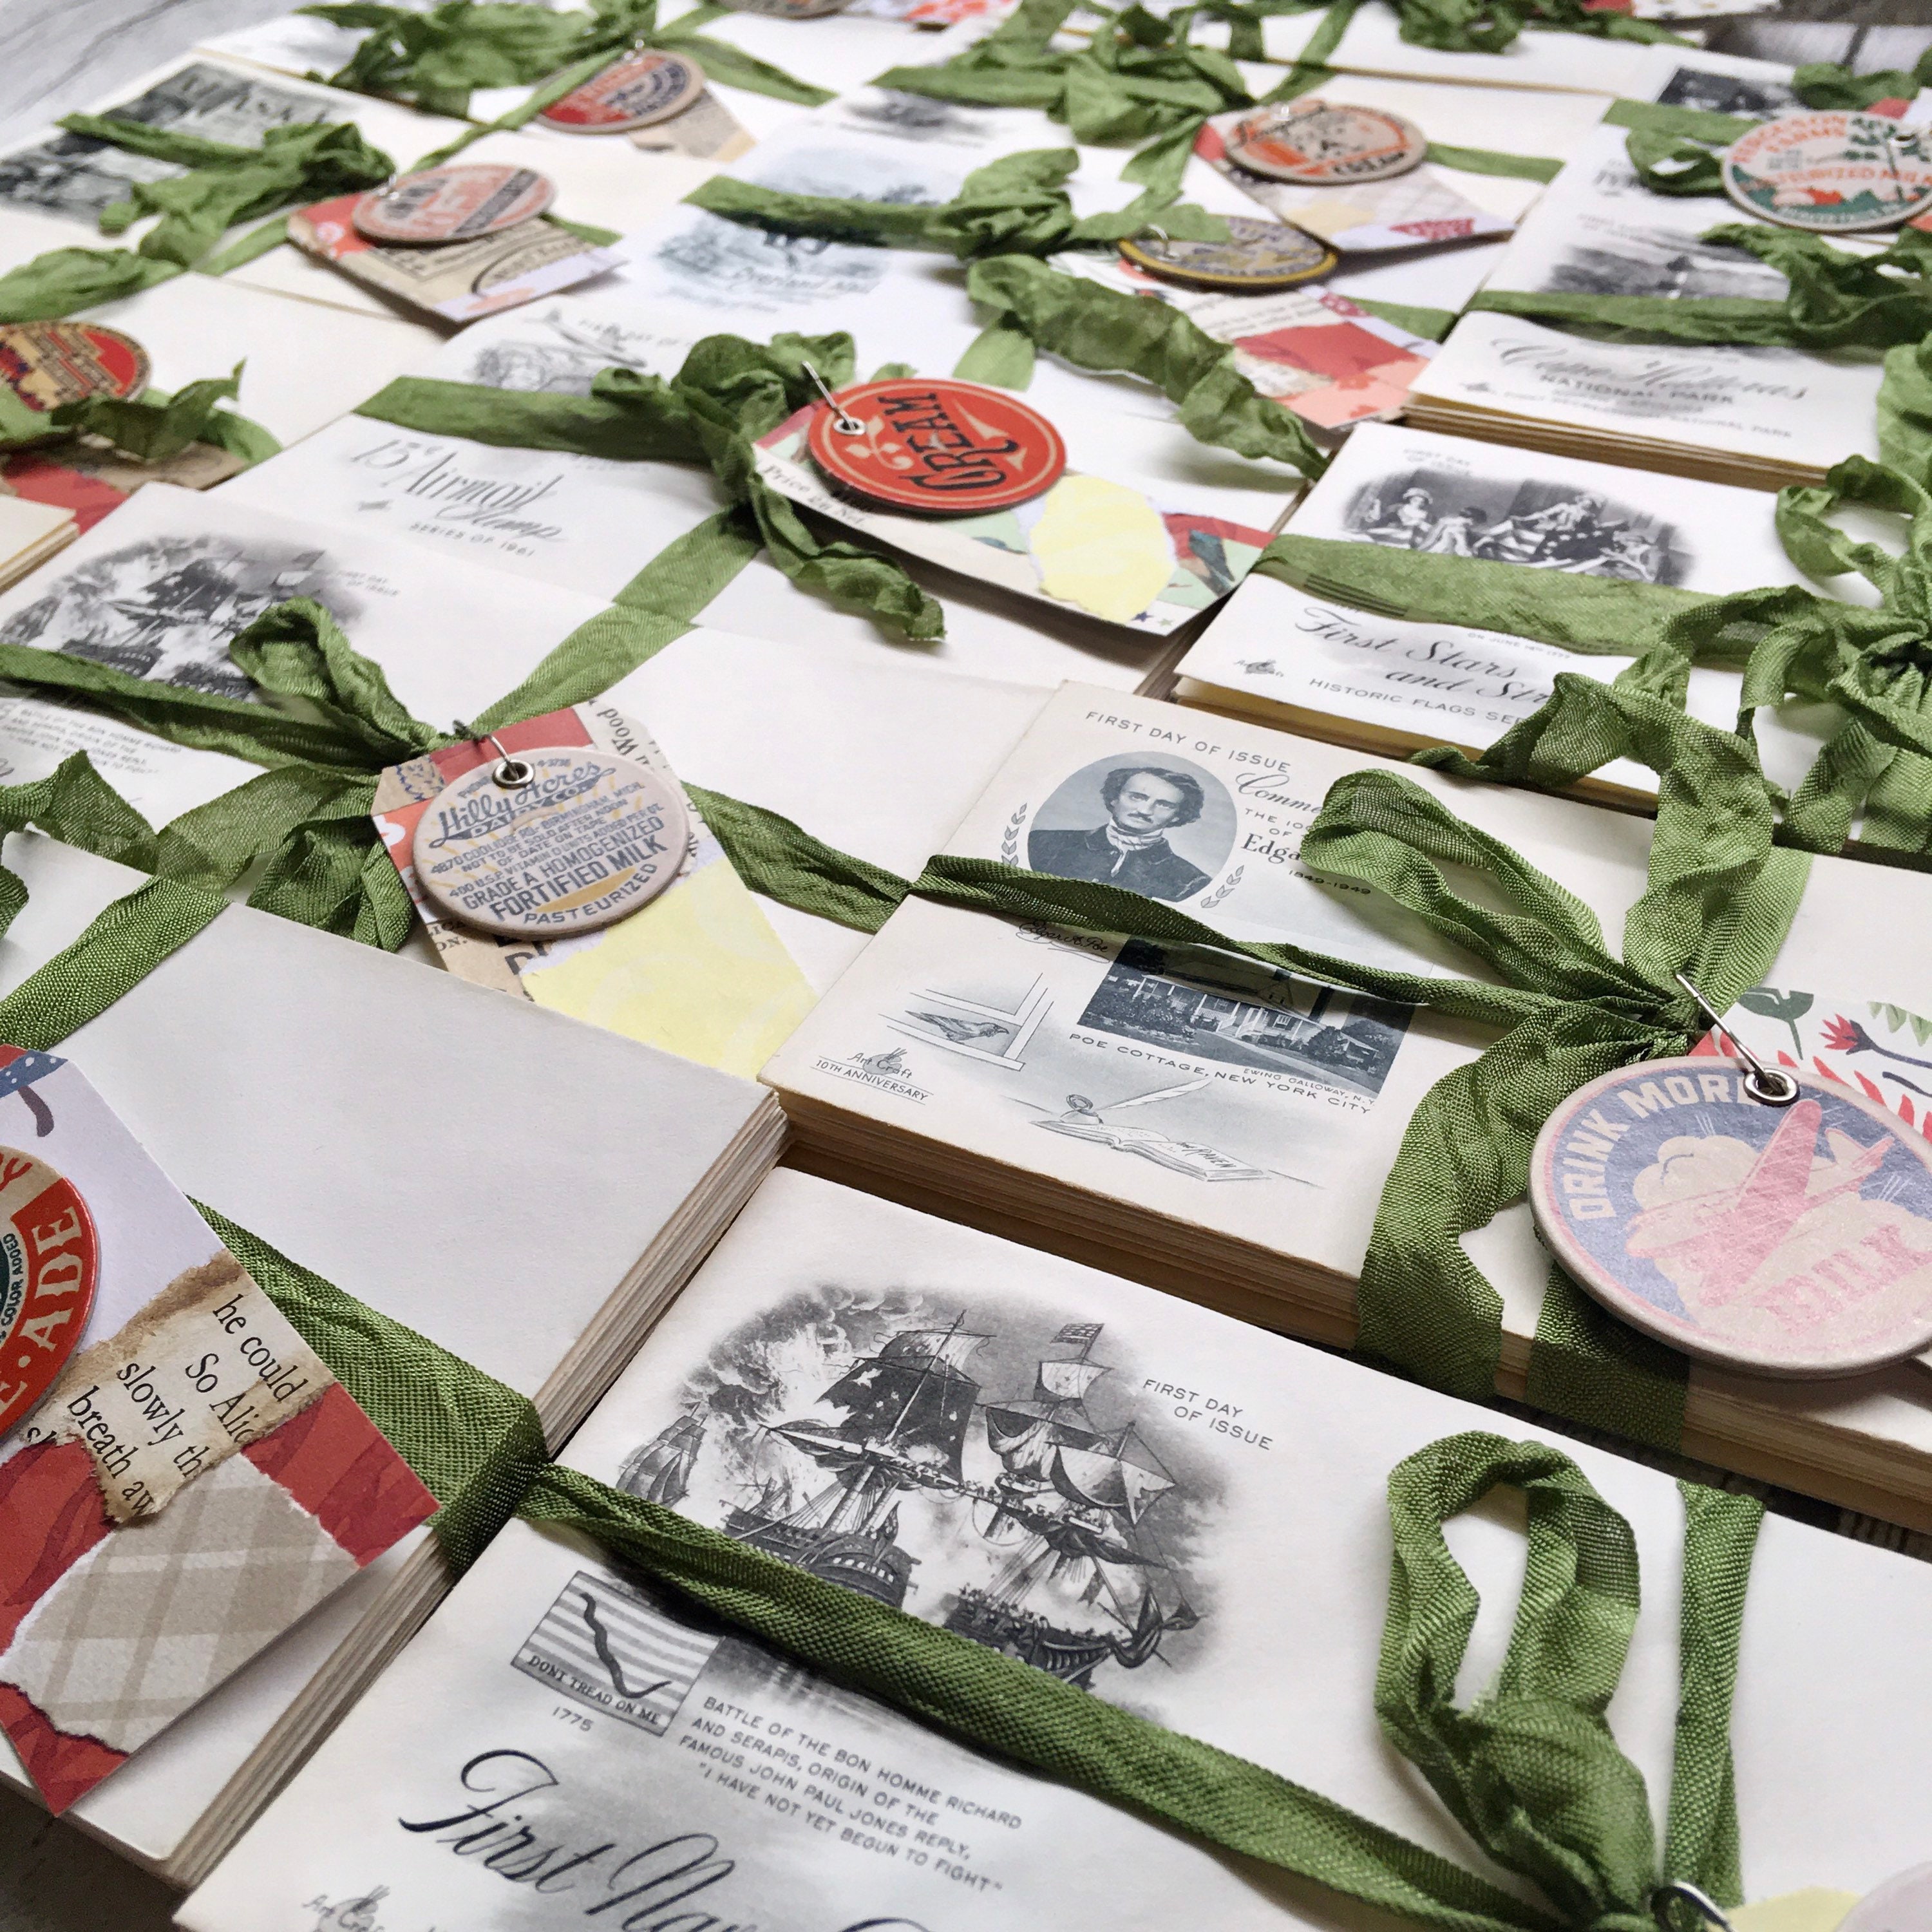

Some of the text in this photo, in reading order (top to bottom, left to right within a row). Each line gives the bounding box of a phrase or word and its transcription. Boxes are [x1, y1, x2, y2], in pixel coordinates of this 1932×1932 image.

[877, 392, 1019, 491] CREAM
[409, 522, 466, 540] SERIES
[1294, 606, 1519, 679] First Stars
[1309, 677, 1403, 704] HISTORIC
[1412, 698, 1477, 717] FLAGS
[1385, 668, 1472, 692] and
[596, 708, 639, 755] Wood
[1086, 710, 1291, 773] FIRST DAY OF ISSUE
[430, 761, 601, 848] Hilly Acres
[1245, 808, 1278, 824] THE
[1269, 828, 1292, 837] OF
[450, 883, 475, 896] 400
[504, 851, 551, 875] VITAMIN
[592, 819, 627, 838] ADDED
[461, 858, 487, 872] NOT
[488, 850, 506, 860] TO
[507, 842, 524, 853] BE
[524, 829, 557, 844] SOLD
[558, 813, 592, 833] AFTER
[462, 876, 523, 910] GRADE
[522, 871, 539, 887] A
[539, 815, 665, 879] HOMOGENIZED
[497, 816, 607, 867] OF DATE ON TAPE
[489, 834, 668, 923] FORTIFIED MILK
[524, 863, 658, 925] PASTEURIZED
[1289, 869, 1372, 895] 1849-1949
[816, 1059, 929, 1101] 10TH ANNIVERSARY
[847, 1052, 913, 1079] Art Craft
[1069, 1033, 1371, 1114] POE COTTAGE, NEW YORK CITY
[1243, 1068, 1282, 1081] EWING
[1288, 1077, 1350, 1099] GALLOWAY,
[1182, 1146, 1238, 1169] RAVEN
[1562, 1110, 1631, 1222] DRINK
[1, 1233, 24, 1326] COLOR ADDED
[185, 1352, 219, 1394] So
[213, 1294, 308, 1403] he could
[117, 1362, 185, 1447] slowly
[1142, 1378, 1244, 1418] FIRST DAY
[1173, 1405, 1274, 1451] OF ISSUE
[67, 1385, 139, 1479] breath
[527, 1655, 661, 1725] DONT TREAD ON ME
[552, 1707, 594, 1732] 1775
[692, 1717, 940, 1826] AND SERAPIS, ORIGIN OF THE
[703, 1696, 1023, 1830] BATTLE OF THE BON HOMME RICHARD
[398, 1749, 616, 1894] First
[678, 1734, 971, 1861] FAMOUS JOHN PAUL JONES REPLY,
[717, 1772, 761, 1800] HAVE
[764, 1793, 802, 1817] NOT
[806, 1810, 837, 1833] YET
[840, 1826, 900, 1857] BEGUN
[905, 1848, 929, 1867] TO
